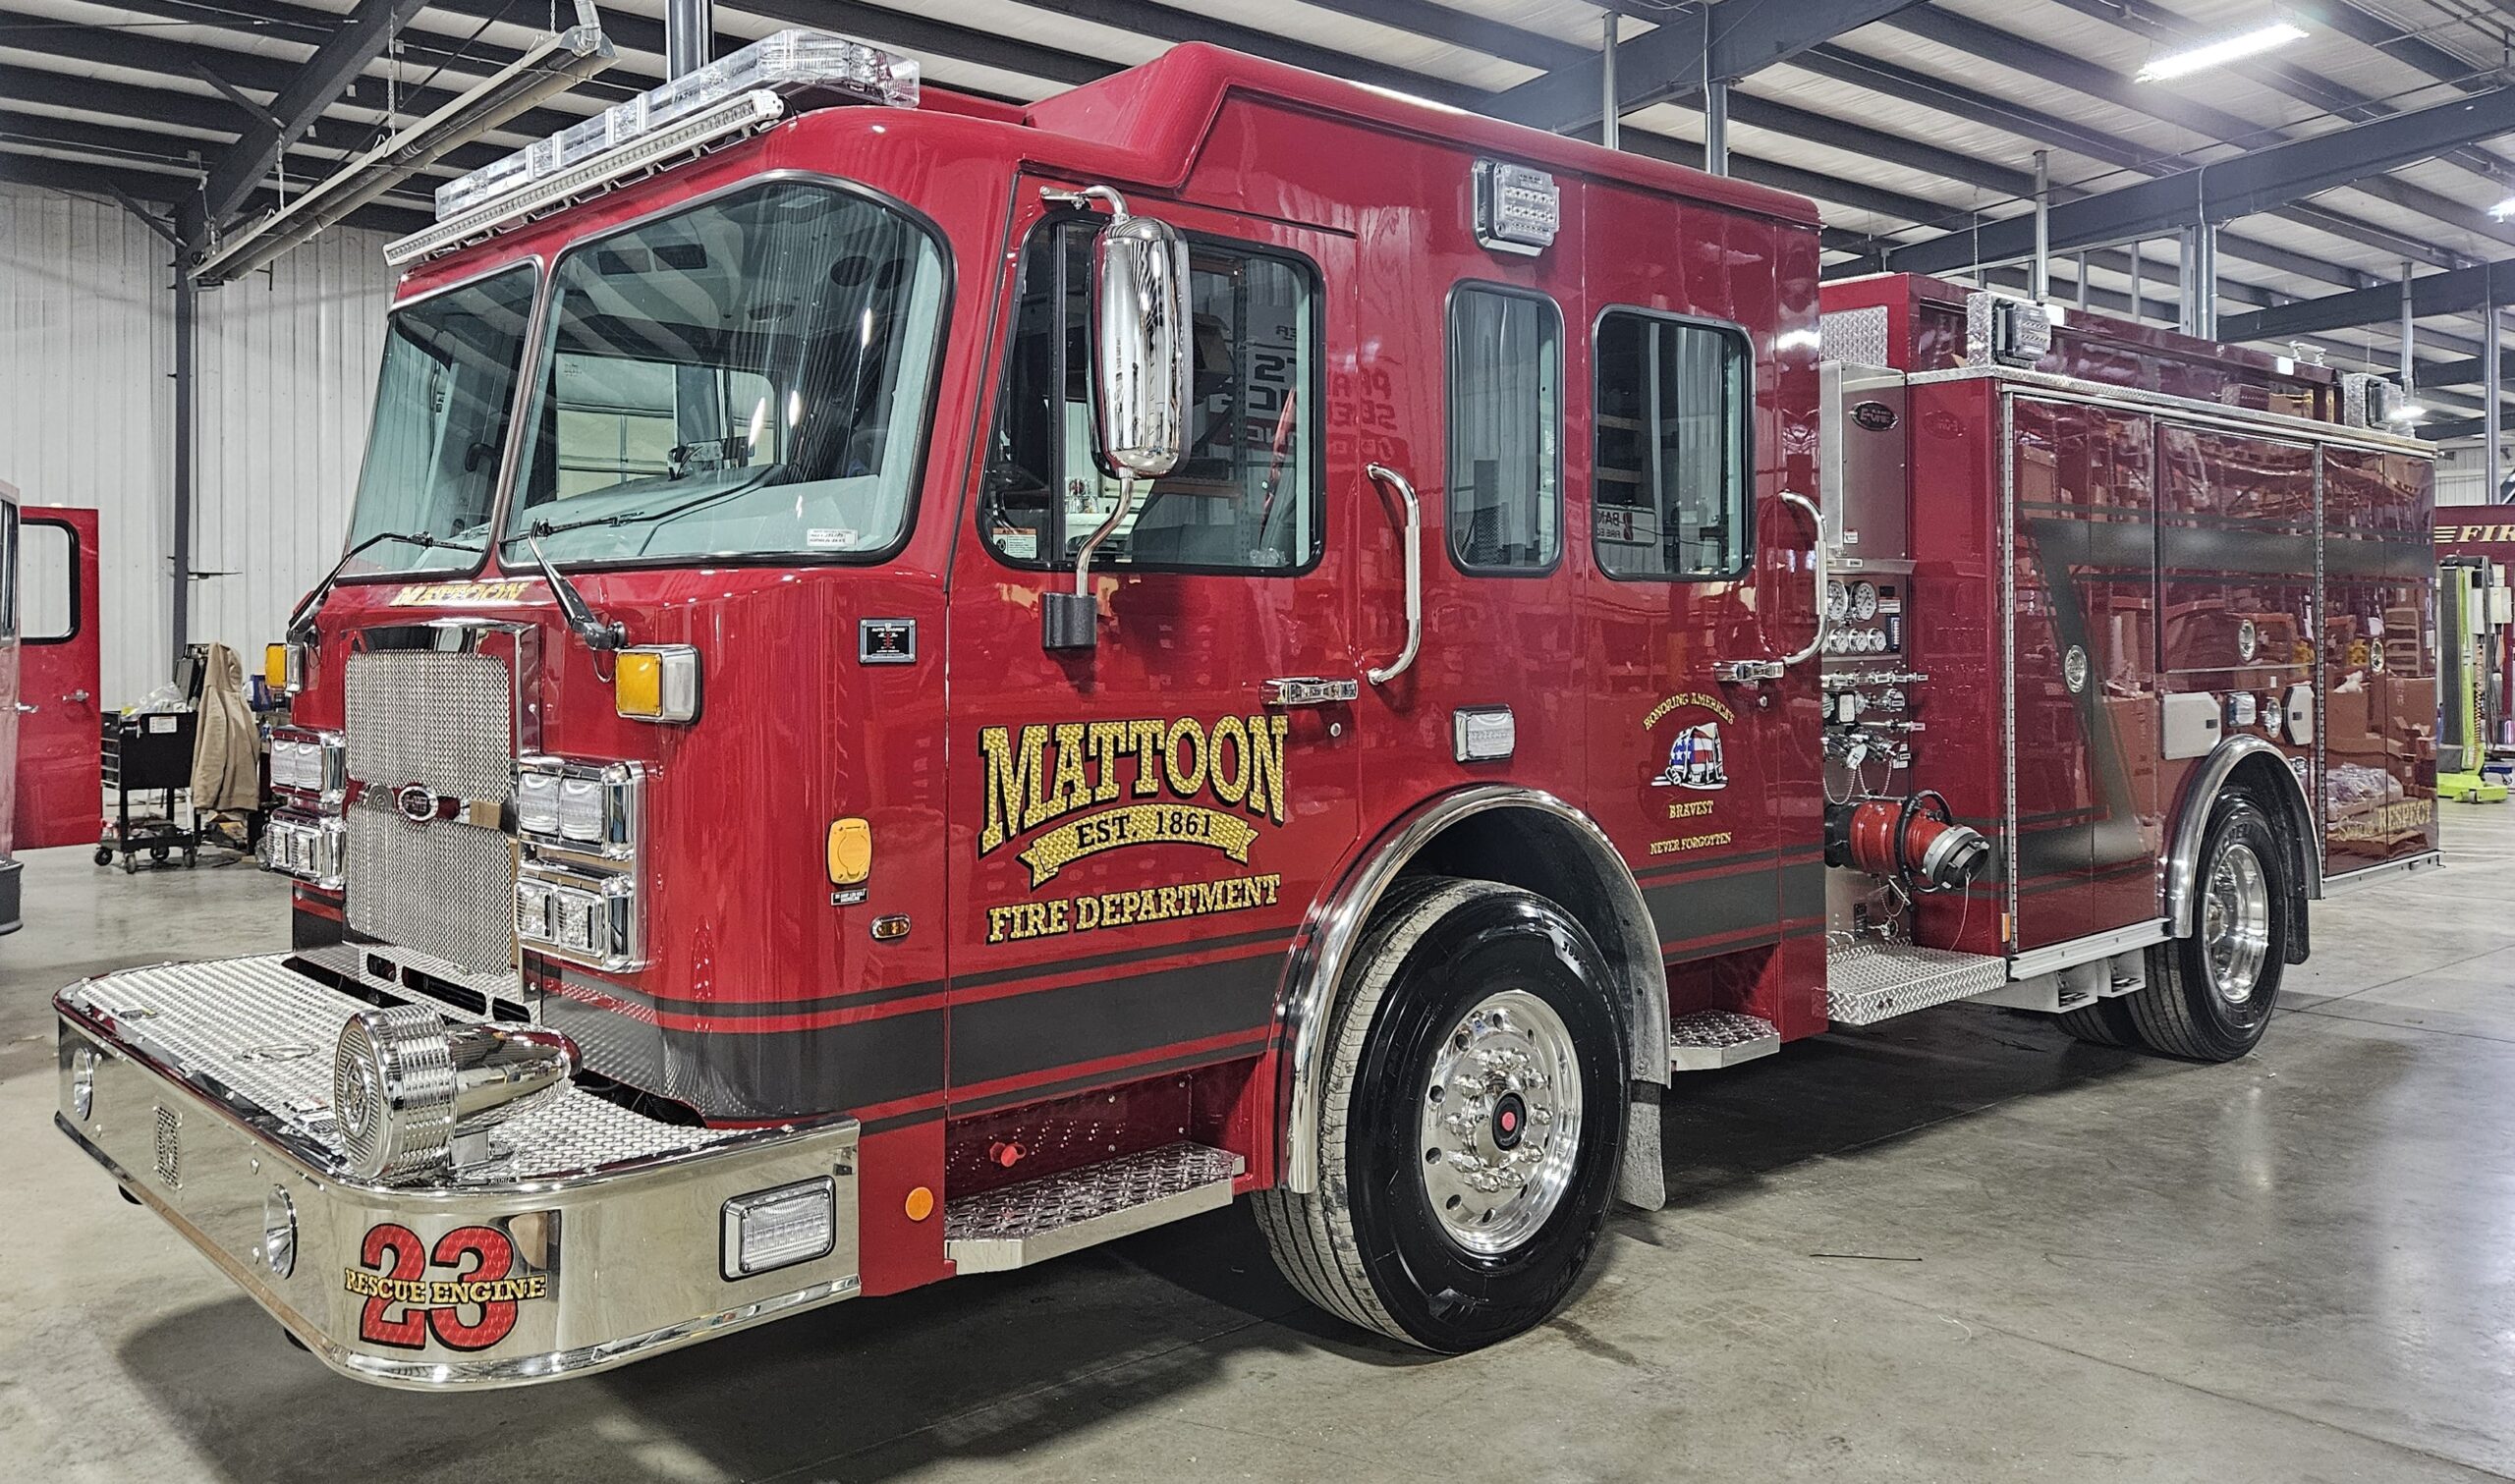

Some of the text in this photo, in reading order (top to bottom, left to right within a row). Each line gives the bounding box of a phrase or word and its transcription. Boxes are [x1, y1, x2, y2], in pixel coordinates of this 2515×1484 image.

[388, 581, 531, 607] MATTOON
[1643, 693, 1689, 730] HONORING
[978, 715, 1289, 859] MATTOON
[1668, 800, 1714, 819] BRAVEST
[2378, 798, 2433, 830] RESPECT
[1076, 811, 1212, 850] EST. 1861
[1649, 832, 1733, 855] NEVER FORGOTTEN
[986, 873, 1281, 945] FIRE DEPARTMENT
[344, 1267, 547, 1304] RESCUE ENGINE
[360, 1222, 519, 1352] 23
